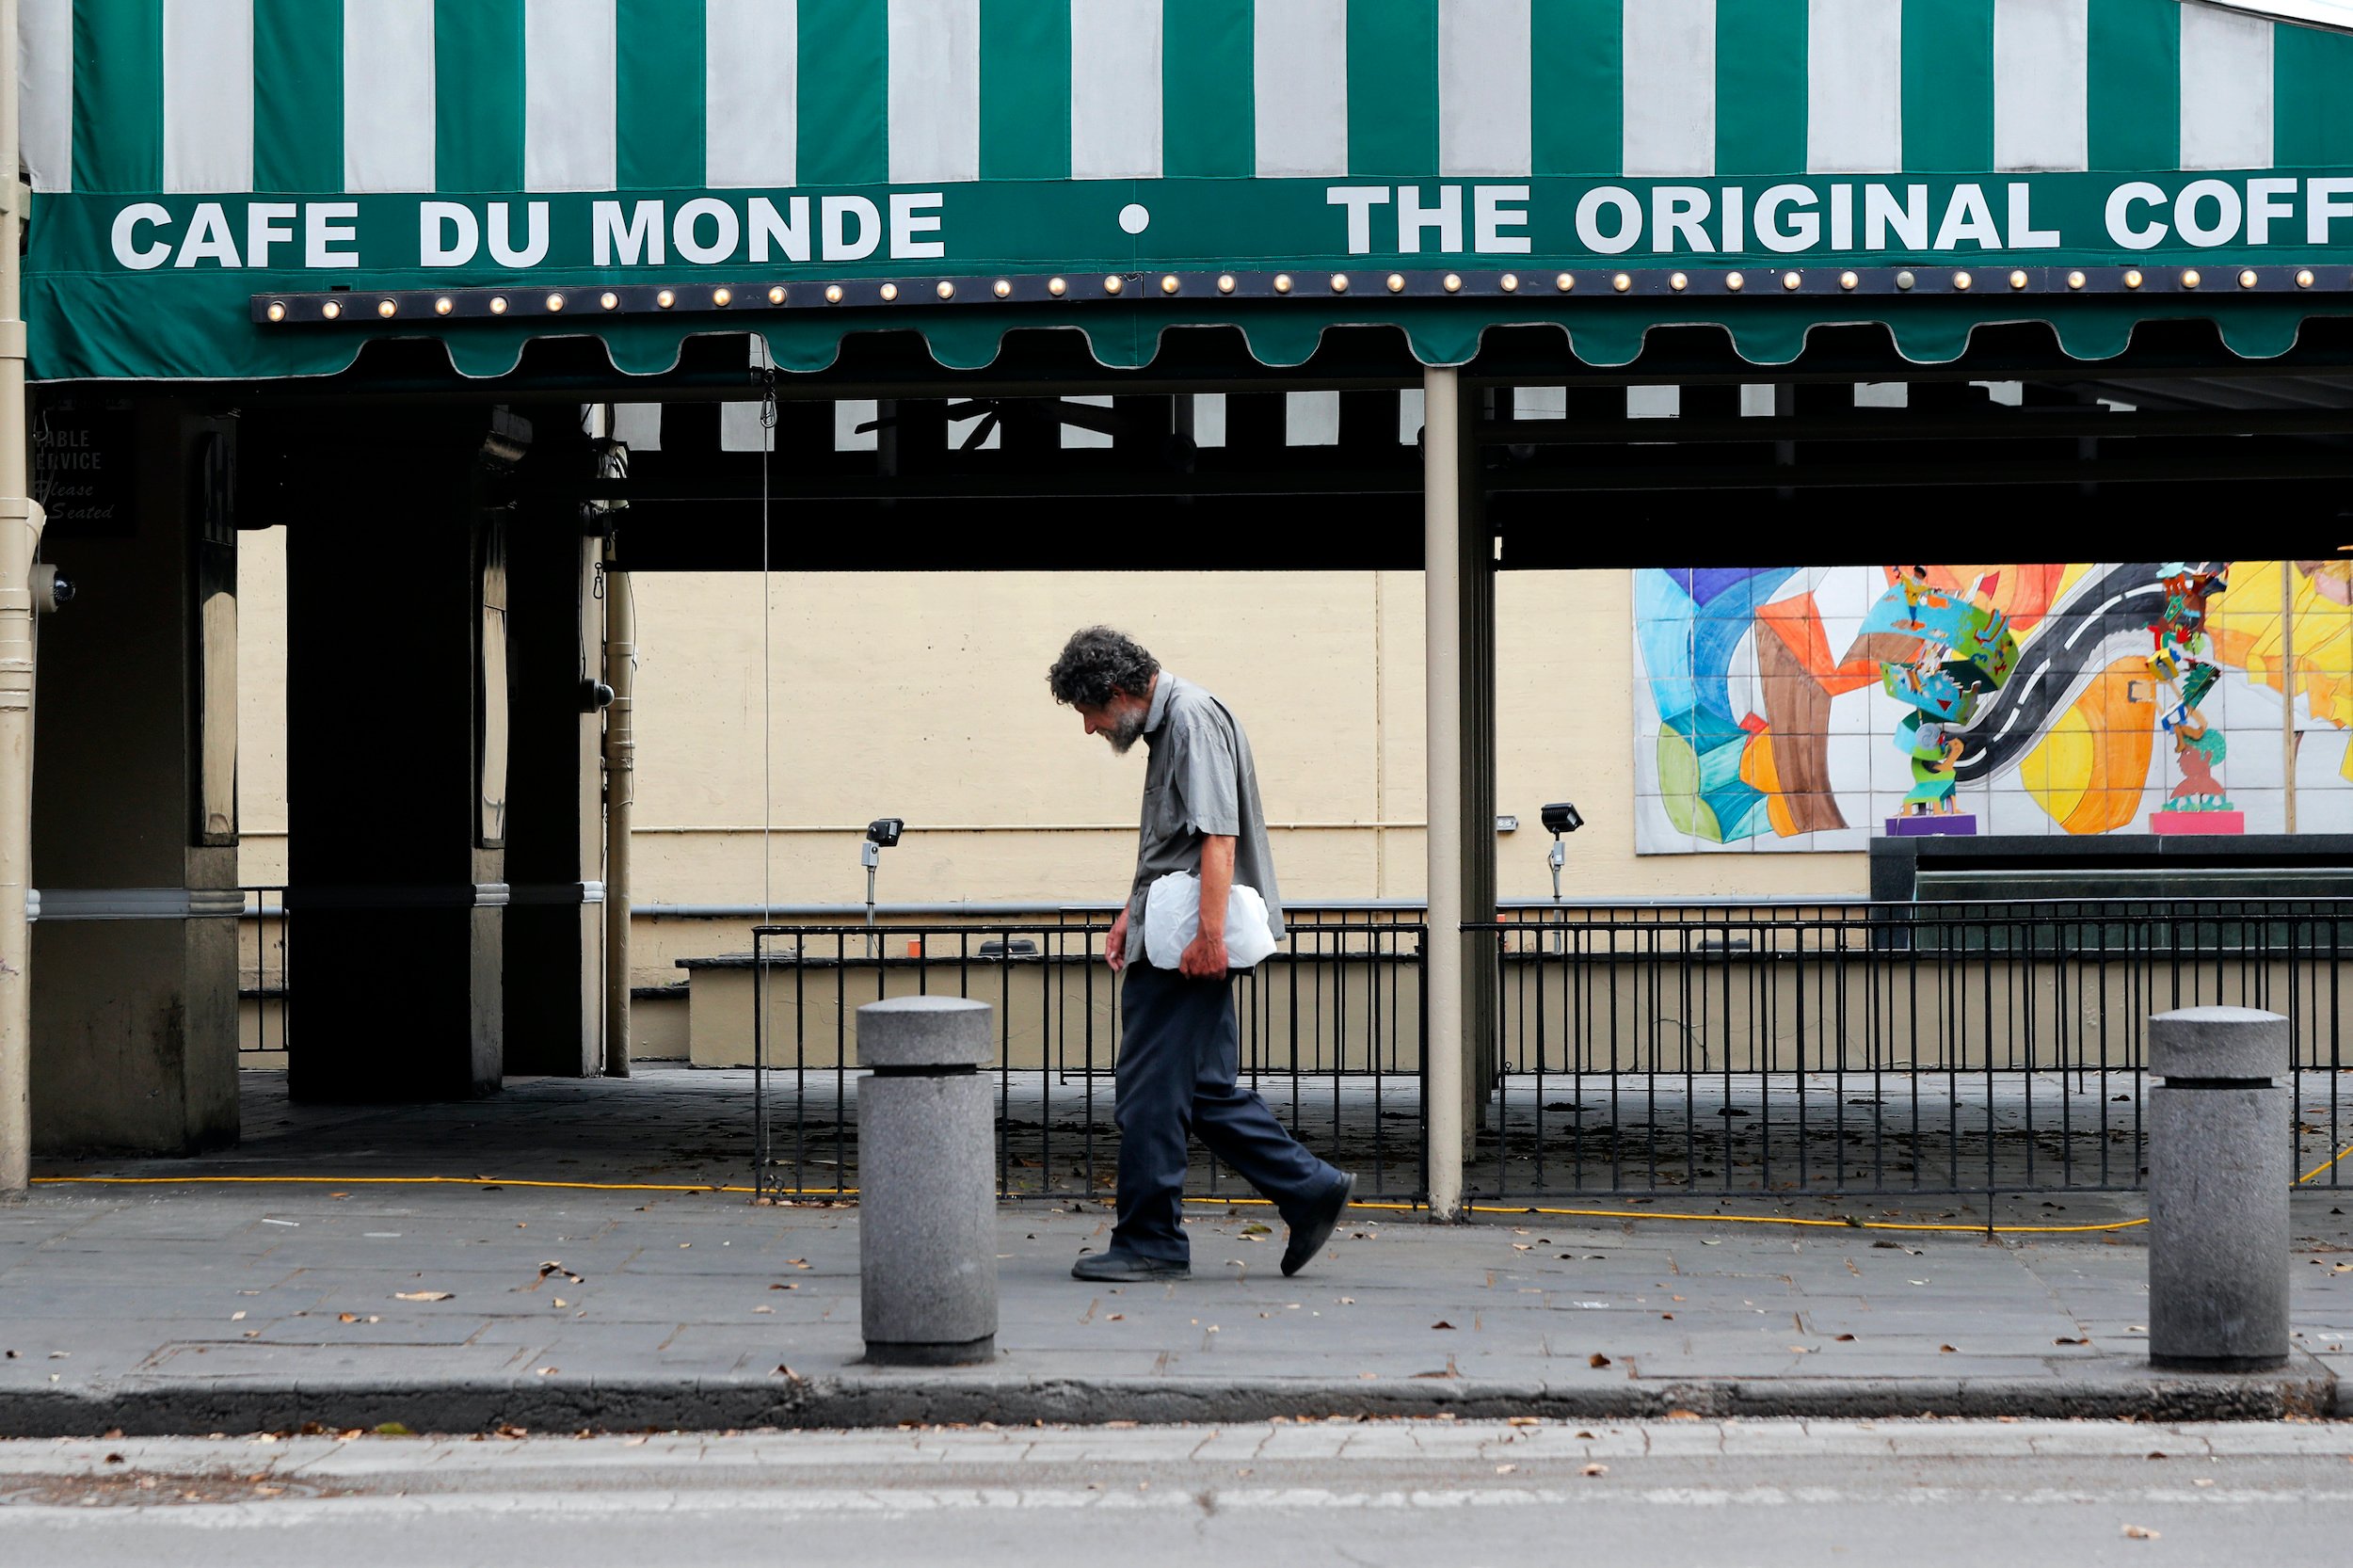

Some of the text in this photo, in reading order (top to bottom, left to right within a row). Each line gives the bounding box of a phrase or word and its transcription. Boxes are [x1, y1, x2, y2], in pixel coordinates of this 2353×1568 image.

[111, 177, 2353, 270] CAFE DU MONDE THE ORIGINAL COFF
[48, 502, 115, 520] Seated
